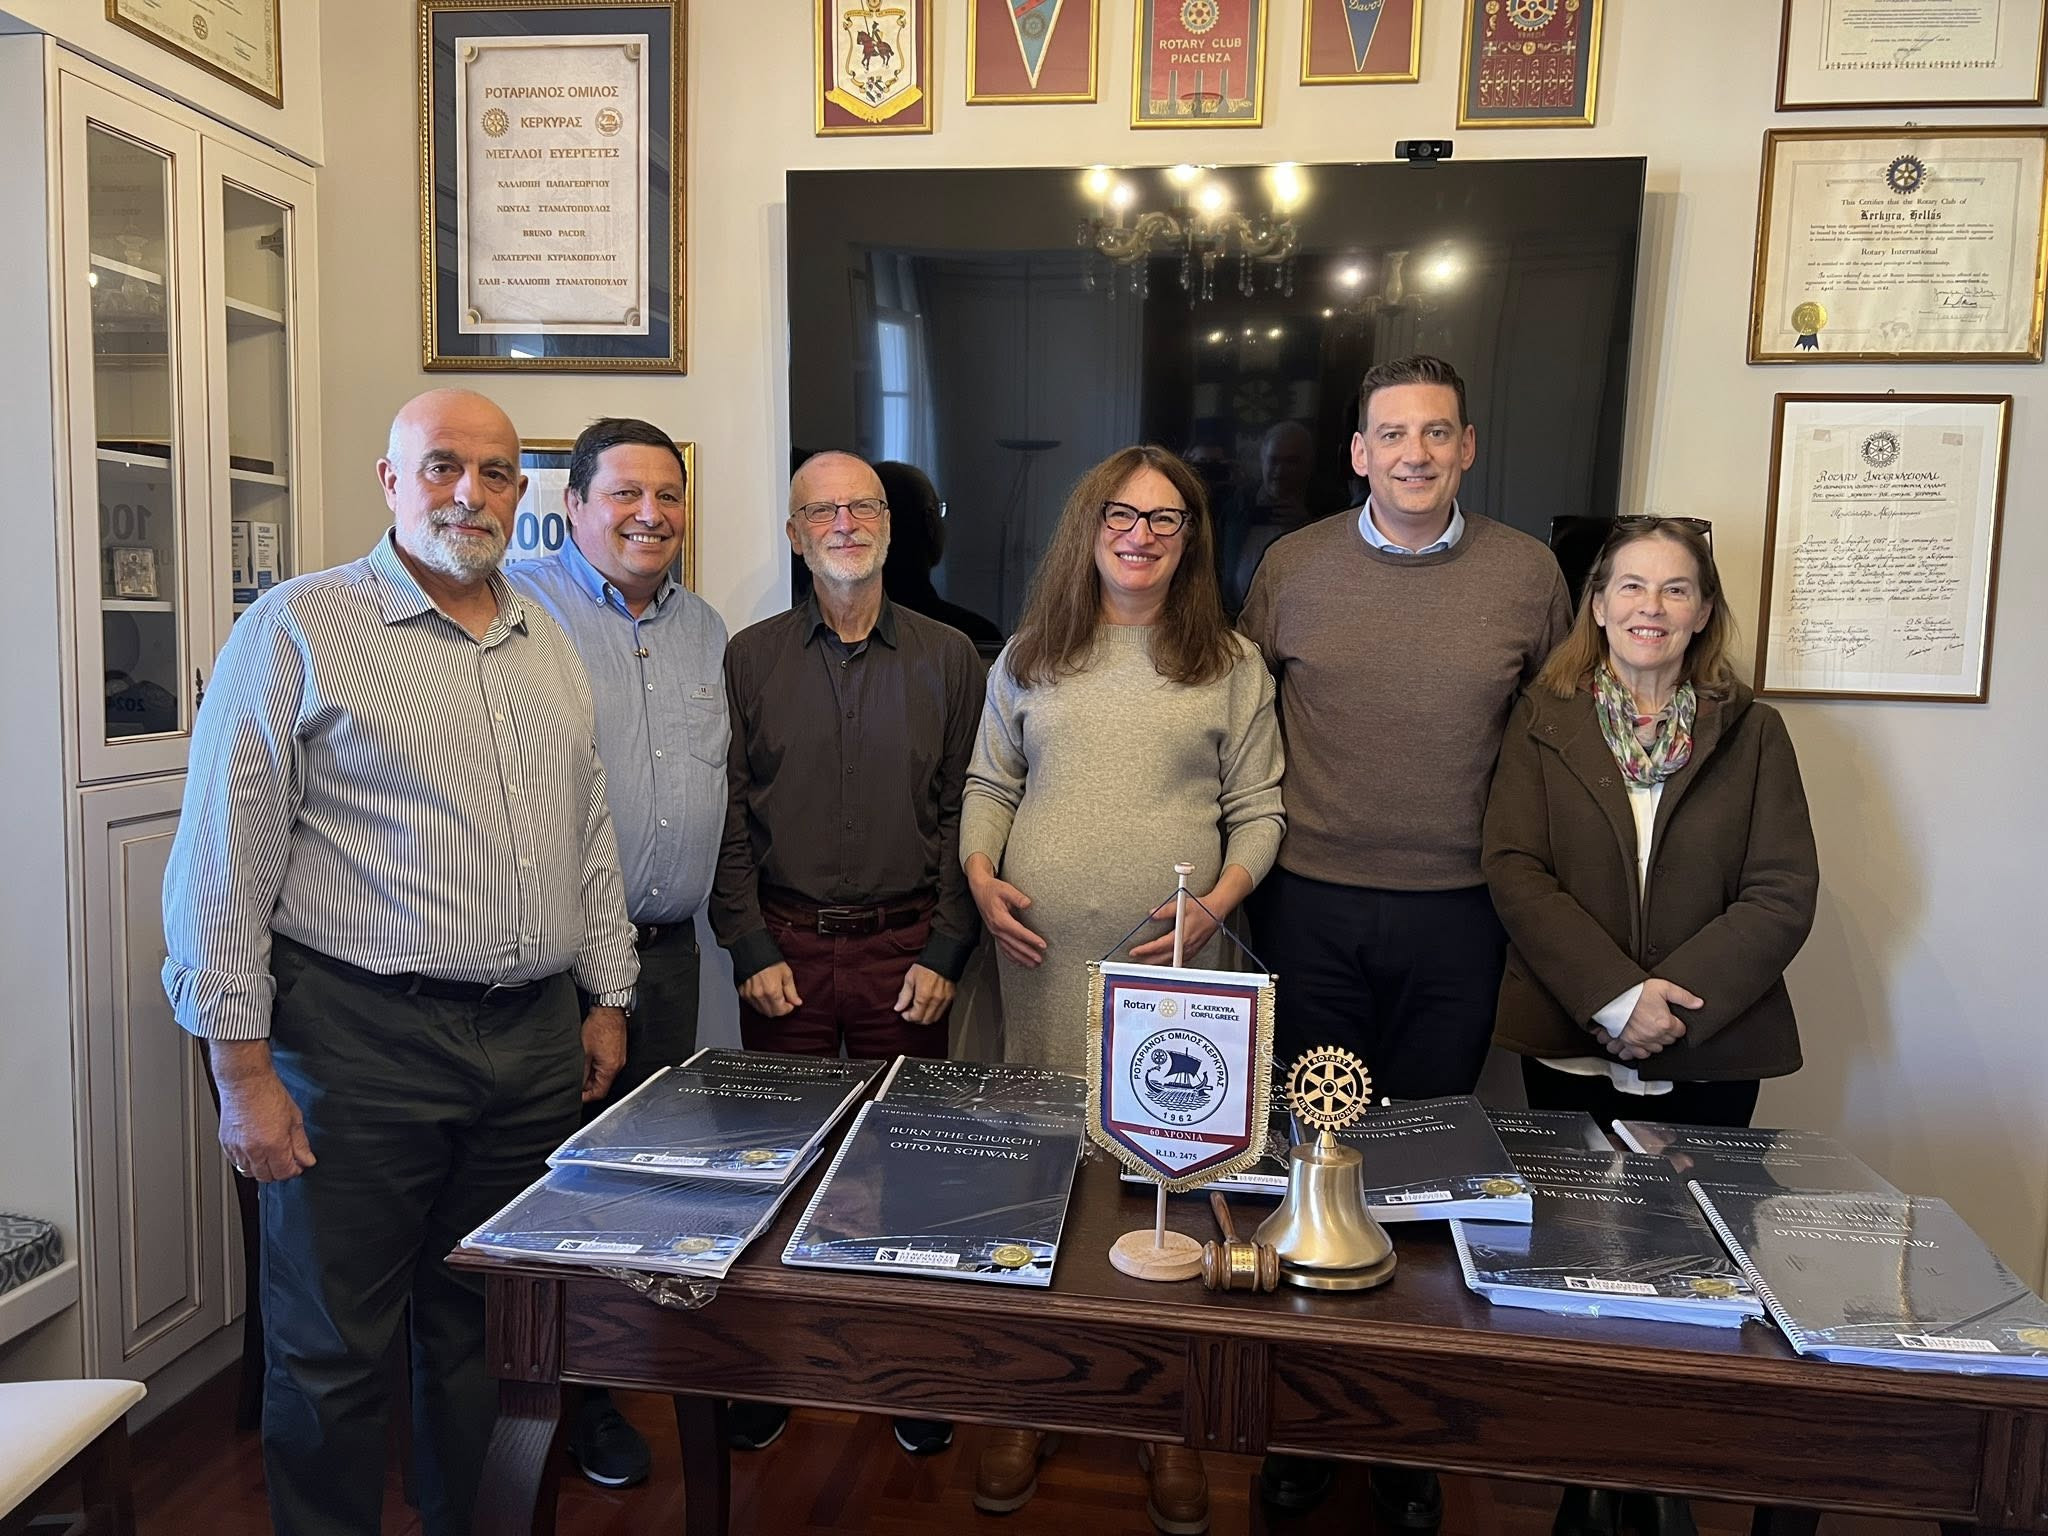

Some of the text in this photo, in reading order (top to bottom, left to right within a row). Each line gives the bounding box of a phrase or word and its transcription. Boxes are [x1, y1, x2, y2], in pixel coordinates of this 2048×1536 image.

[1160, 38, 1242, 49] ROTARY CLUB
[1171, 53, 1231, 63] PIACENZA
[485, 86, 619, 99] ΡΟΤΑΡΙΑΝΟΣ ΟΜΙΛΟΣ
[521, 117, 582, 128] ΚΕΡΚΥΡΑΣ
[486, 148, 619, 159] ΜΕΓΑΛΟΙ ΕΥΕΡΓΕΤΕΣ
[546, 180, 610, 188] ΠΑΠΑΓΕΩΡΓΙΟΥ
[1917, 198, 1938, 206] Rotary
[497, 205, 611, 213] ΝΩΝΤΑΣ ΣΤΑΜΑΤΟΠΟΥΛΟΣ
[1861, 247, 1938, 256] Rotary International
[492, 254, 542, 262] ΑΙΚΑΤΕΡΙΝΗ
[555, 278, 628, 286] ΣΤΑΜΑΤΟΠΟΥΛΟΥ
[508, 512, 565, 551] 00
[1123, 999, 1156, 1012] Rotary
[1191, 1004, 1235, 1013] R.C.KERKYRA
[1134, 1032, 1224, 1088] ΡΟΤΑΡΙΑΝΟΣ ΟΜΙΛΟΣ ΚΕΡΚΥΡΑΣ
[1311, 1055, 1349, 1065] ROTARY
[720, 1083, 776, 1093] JOYRIDE
[678, 1087, 715, 1095] OTTO
[735, 1092, 803, 1102] SCHWARZ
[1298, 1099, 1359, 1122] INTERNATIONAL
[1163, 1112, 1193, 1122] 1962
[1351, 1114, 1435, 1128] OUCHDOWN
[889, 1126, 931, 1137] BURN
[934, 1130, 965, 1140] THE
[1412, 1123, 1456, 1134] WEBER
[1164, 1131, 1203, 1142] ΧΡΟΝΙΑ
[1686, 1137, 1793, 1150] QUADRILLE
[890, 1141, 1030, 1161] OTTO M. SCHWARZ
[1156, 1149, 1198, 1161] R.I.D. 2475
[1515, 1164, 1547, 1173] ERIN
[1550, 1168, 1582, 1177] VON
[1523, 1172, 1567, 1182] MPRESS
[1543, 1189, 1648, 1205] M. SCHWARZ
[1775, 1207, 1900, 1224] EIFFEL TOWER
[1774, 1228, 1939, 1249] OTTO M. SCHWARZ
